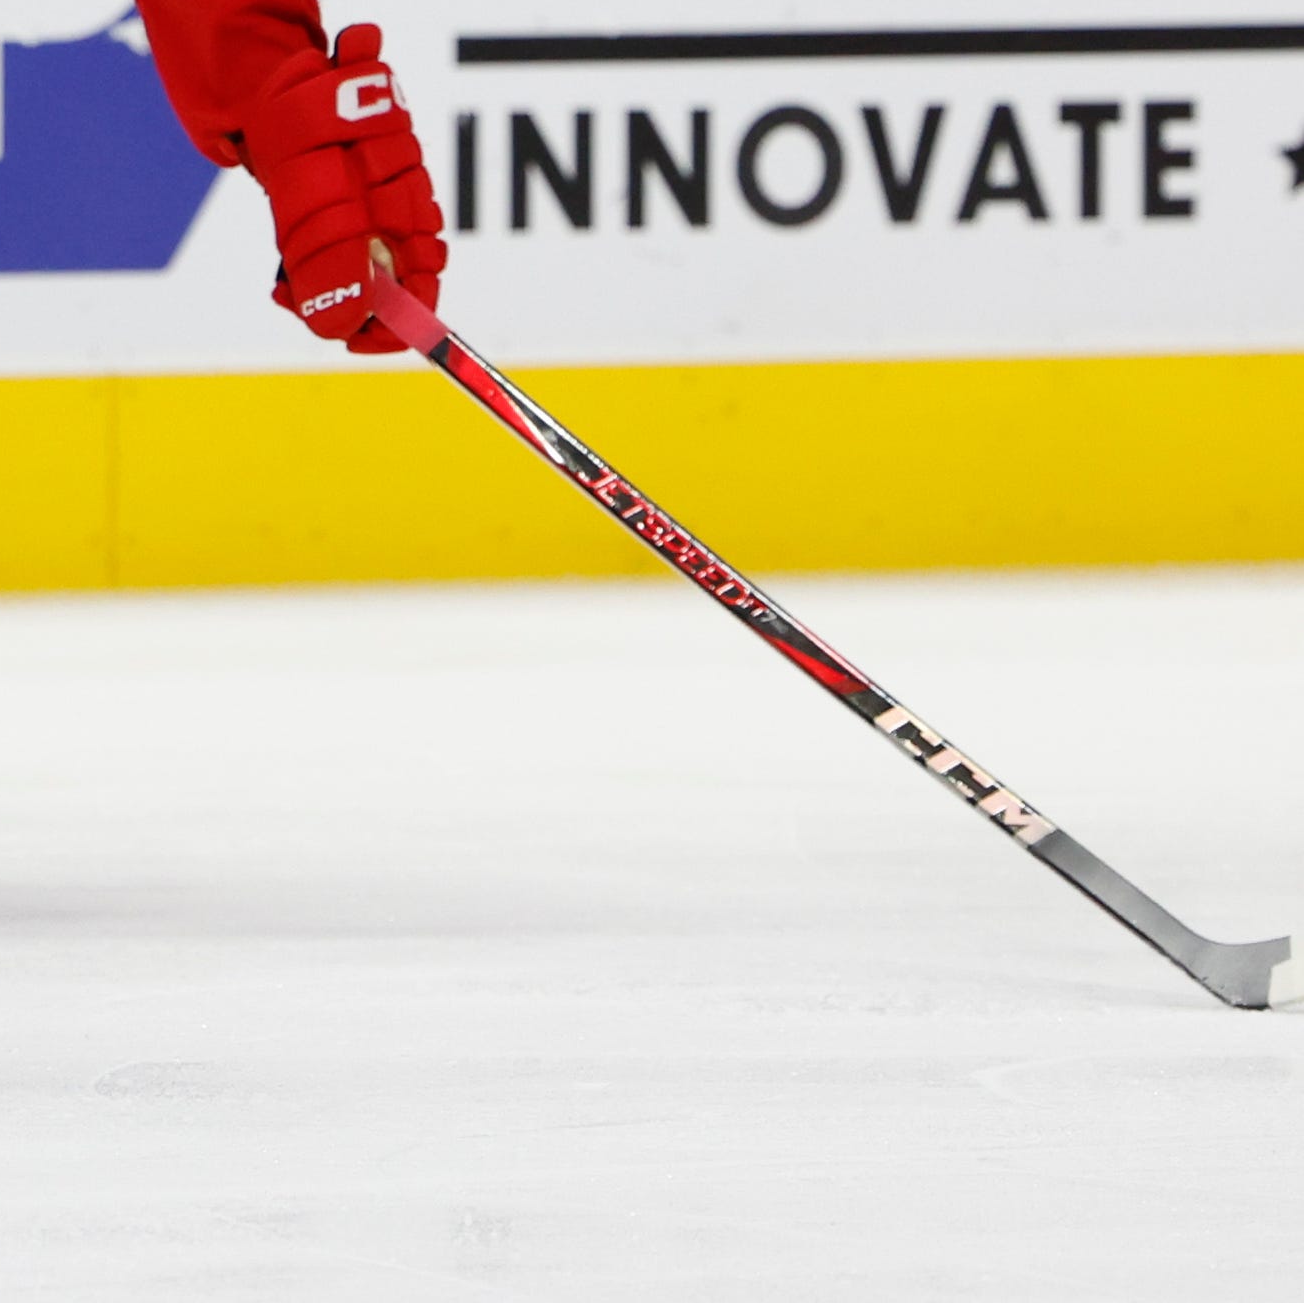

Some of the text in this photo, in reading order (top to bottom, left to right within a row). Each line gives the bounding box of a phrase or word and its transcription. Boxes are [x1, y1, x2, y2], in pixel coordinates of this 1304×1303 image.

[456, 100, 1200, 234] INNOVATE
[301, 282, 362, 317] CCM
[577, 465, 752, 607] JETSPEED
[873, 704, 1057, 845] CCM
